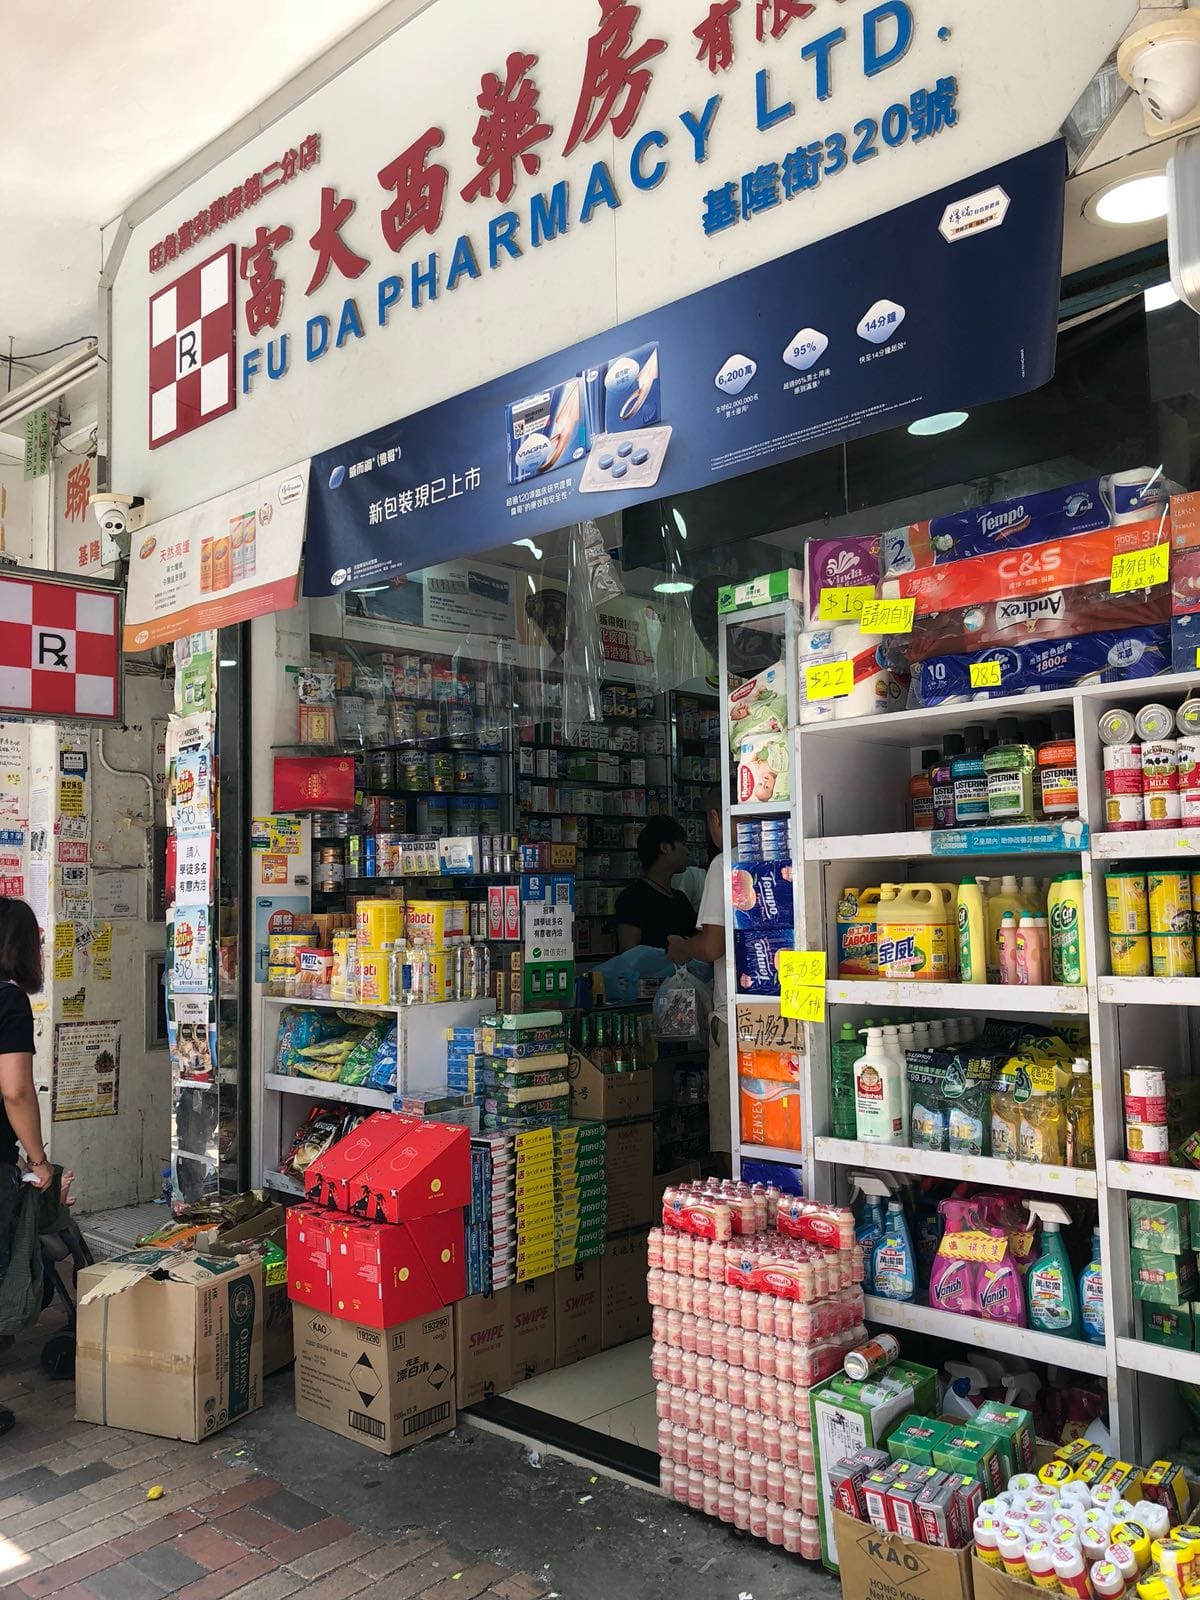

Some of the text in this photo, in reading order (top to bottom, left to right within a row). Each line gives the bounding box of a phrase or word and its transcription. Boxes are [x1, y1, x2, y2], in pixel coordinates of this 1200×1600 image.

[702, 76, 961, 238] 基隆街320號
[242, 0, 953, 395] FU DA PHARMACY LTD.
[864, 311, 898, 333] 14分鐘
[792, 341, 818, 358] 95%
[717, 364, 754, 386] 6,200萬
[517, 442, 549, 458] VIAGRA
[368, 466, 482, 526] 新包裝現已上市
[977, 504, 1025, 537] Tempo
[998, 546, 1062, 580] C&S
[826, 567, 863, 587] Vinda
[1000, 596, 1062, 619] Andrex
[1042, 768, 1078, 780] LISTERINE
[1150, 778, 1169, 787] MILK
[761, 872, 777, 916] Tempo
[302, 954, 317, 965] PRETZ
[878, 936, 914, 966] 金威
[743, 1052, 753, 1074] ZEN
[752, 1101, 764, 1143] ZENSES
[934, 1277, 962, 1301] Vanish
[980, 1286, 1009, 1309] Vanish
[564, 1290, 597, 1313] SWIPE
[312, 1322, 327, 1334] KAO
[514, 1305, 549, 1329] SWIPE
[469, 1323, 505, 1348] SWIPE
[396, 1360, 430, 1384] 漂白水
[867, 1540, 919, 1572] KAO
[870, 1577, 898, 1597] HONG
